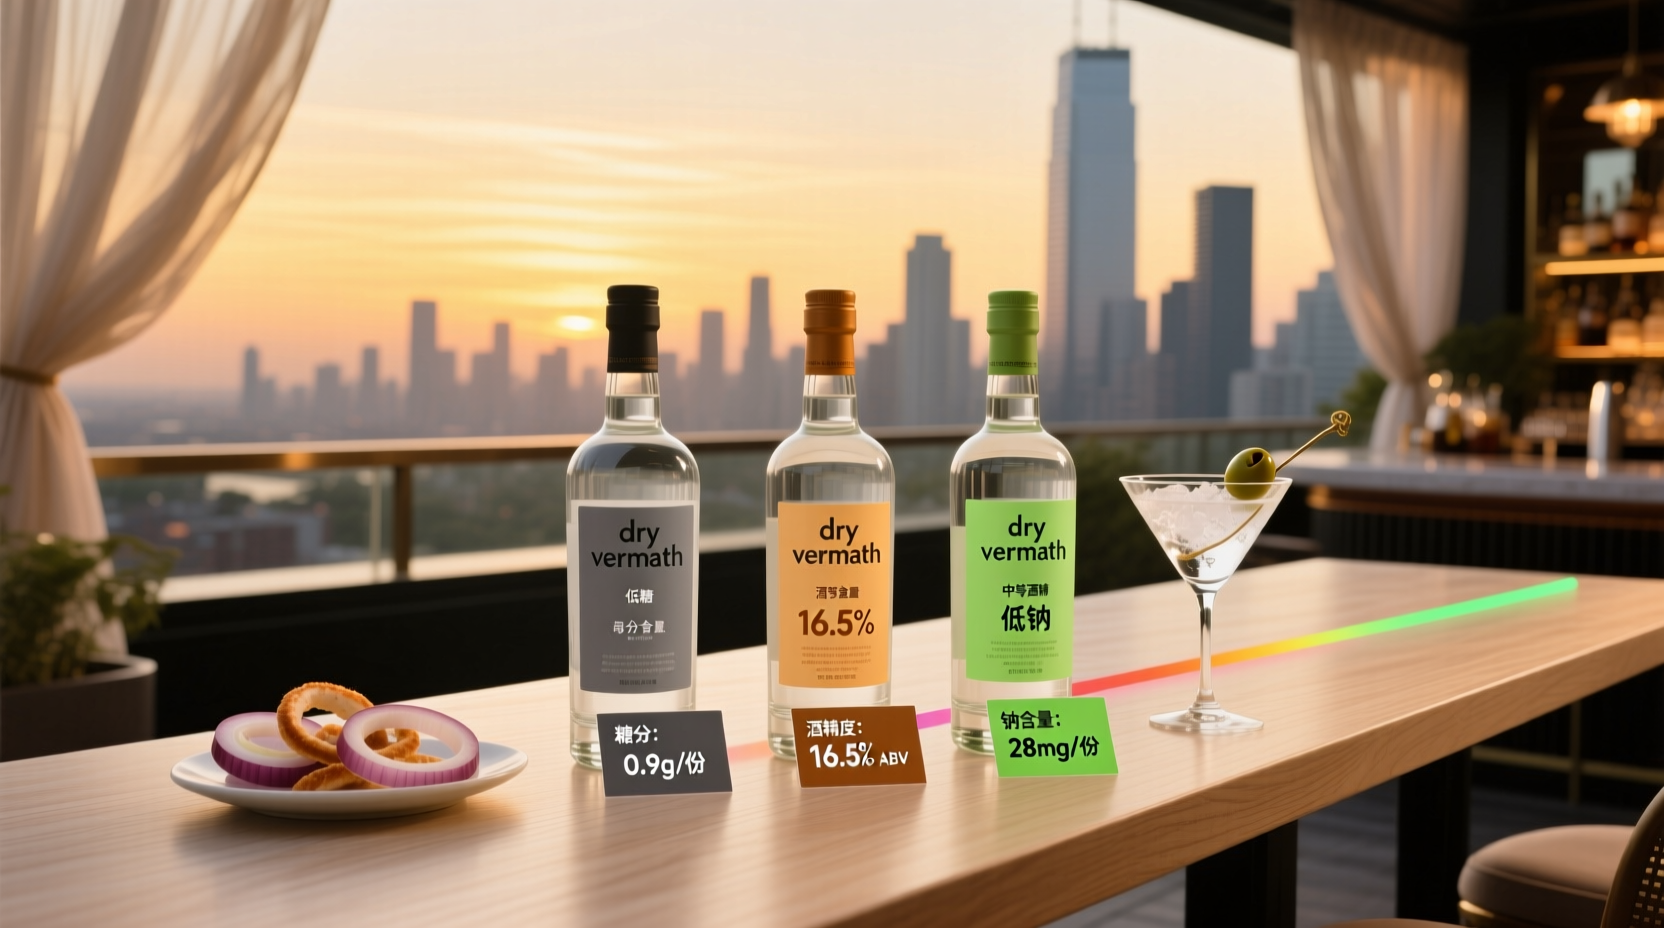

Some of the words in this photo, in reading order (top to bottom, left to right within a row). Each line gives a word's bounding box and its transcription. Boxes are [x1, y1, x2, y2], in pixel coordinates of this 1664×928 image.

[619, 519, 660, 548] dry
[819, 517, 859, 546] dry
[1008, 514, 1046, 543] dry
[591, 544, 683, 567] vermath
[792, 542, 881, 565] vermath
[980, 539, 1066, 561] vermath
[798, 608, 875, 637] 16.5%
[1001, 604, 1051, 632] 低钠
[809, 741, 875, 768] 16.5%
[879, 750, 909, 767] ABV
[1008, 735, 1100, 763] 28mg/份
[624, 751, 706, 780] 0.9g/份
